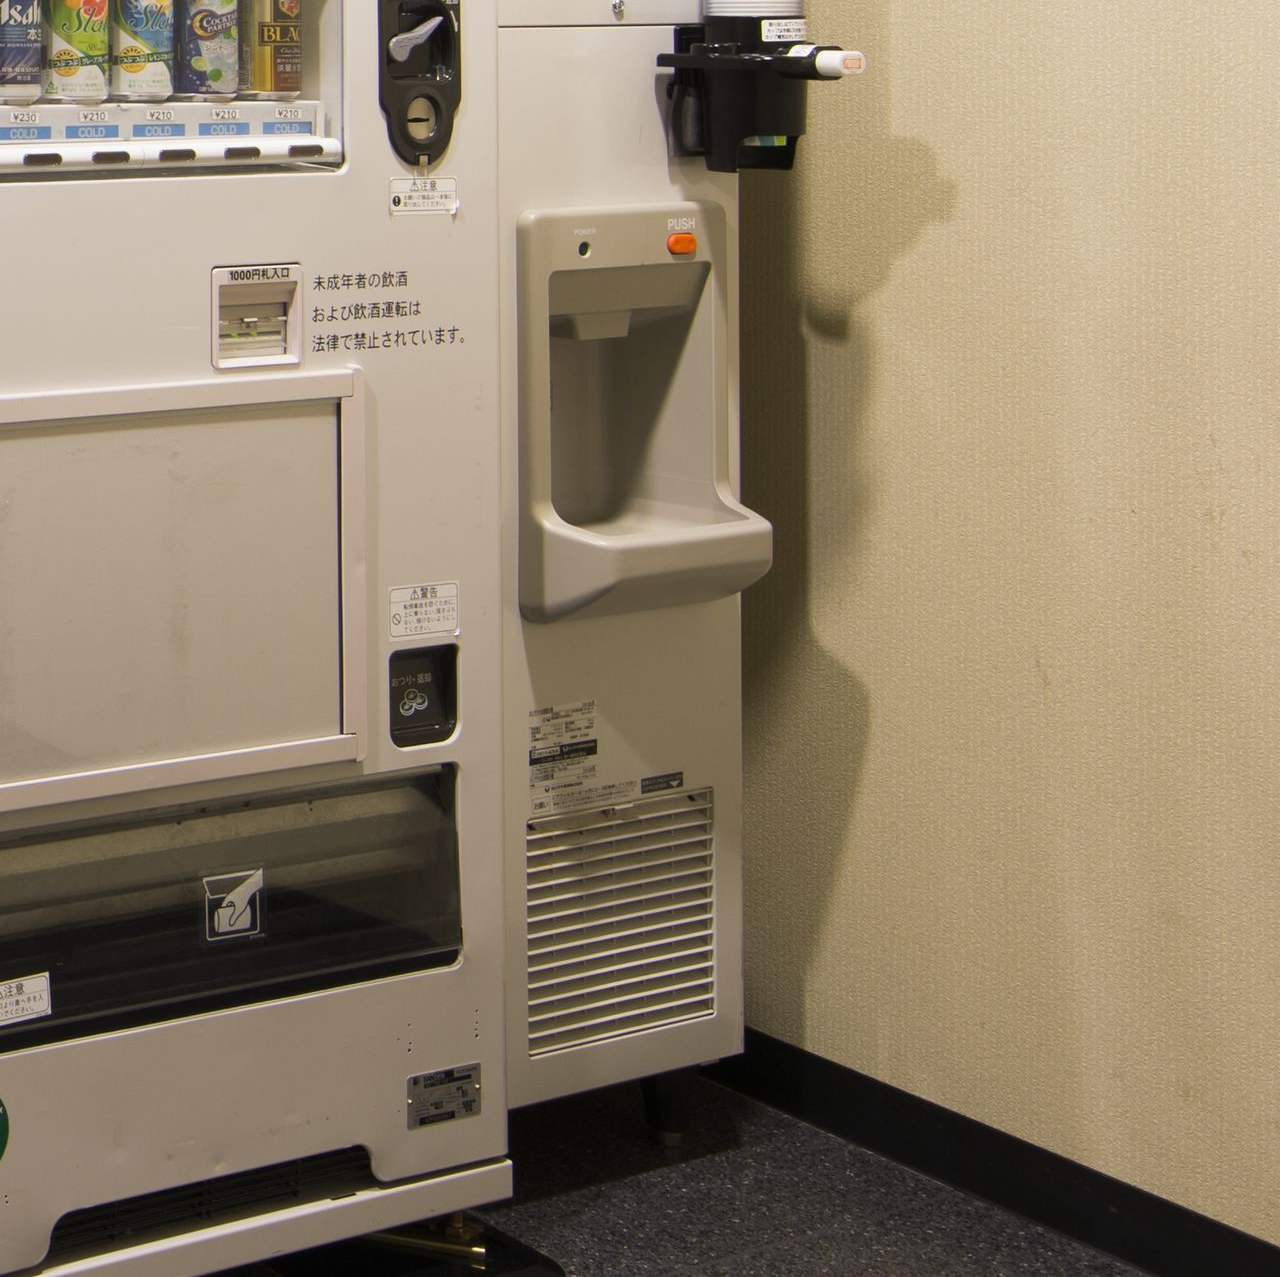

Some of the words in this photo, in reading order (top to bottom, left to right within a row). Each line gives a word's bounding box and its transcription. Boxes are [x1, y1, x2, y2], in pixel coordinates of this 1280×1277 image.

[9, 126, 37, 139] COLD
[145, 124, 171, 137] COLD
[211, 123, 237, 136] COLD
[667, 217, 697, 231] PUSH
[229, 267, 290, 282] 1000円札入口
[312, 270, 408, 291] 未成年者の飲酒
[311, 300, 422, 323] および飲酒運転は
[311, 325, 466, 353] 法律で禁止されています。
[3, 982, 25, 998] 注意
